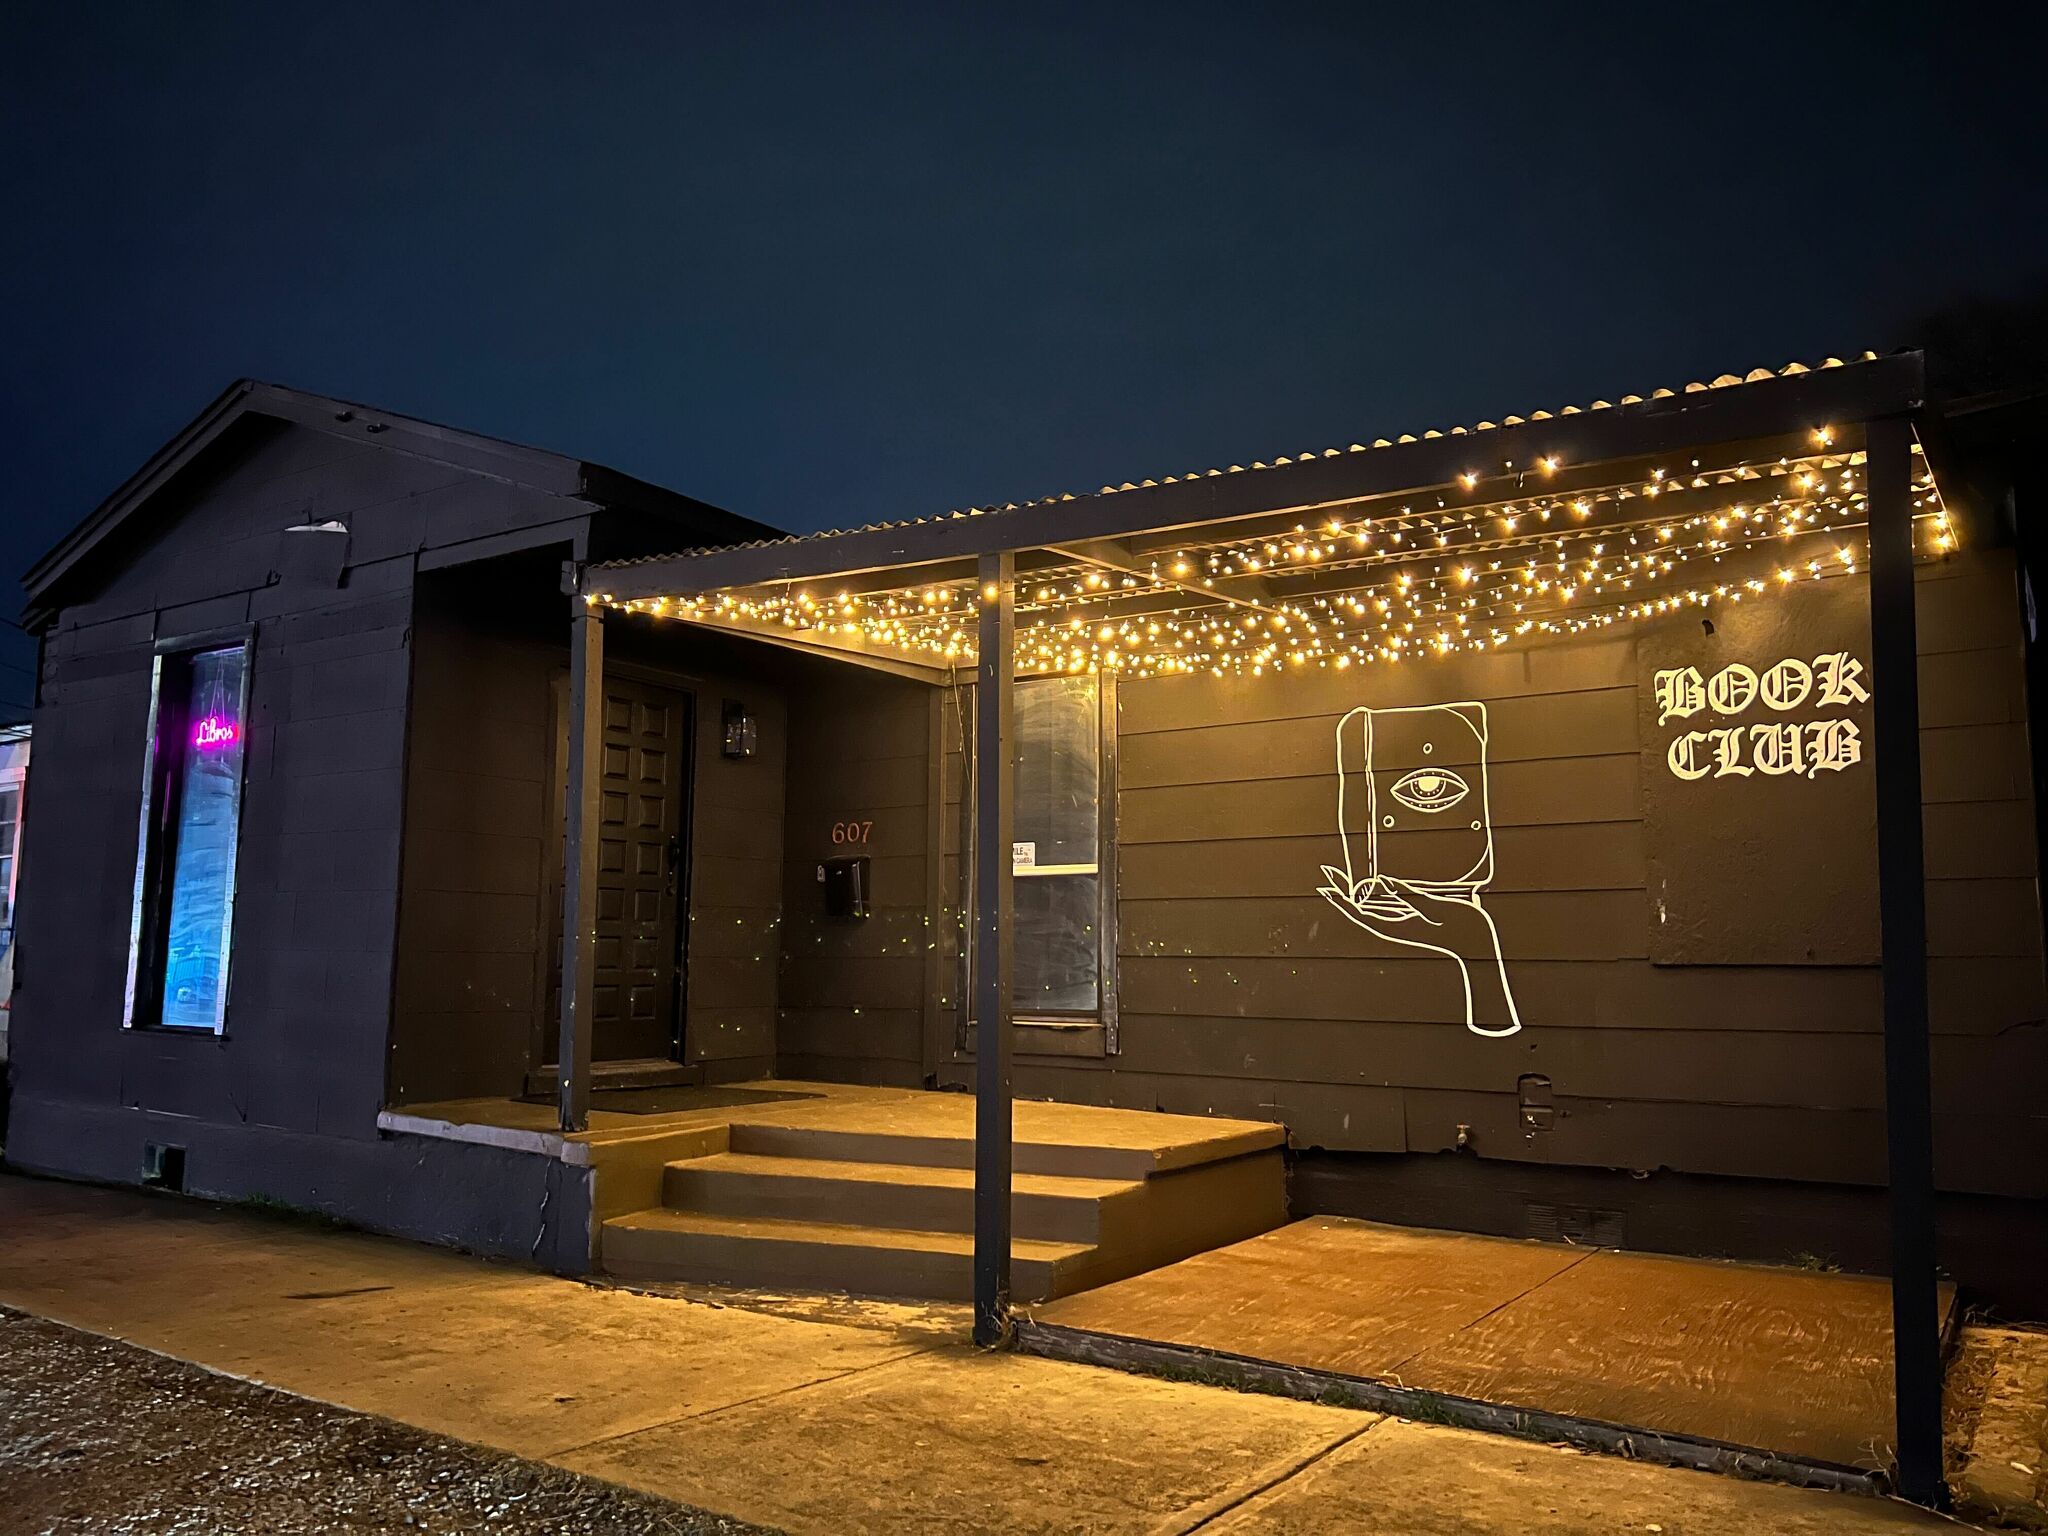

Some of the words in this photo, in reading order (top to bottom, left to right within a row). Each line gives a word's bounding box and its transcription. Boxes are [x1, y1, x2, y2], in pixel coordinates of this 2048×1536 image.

[1654, 652, 1870, 726] BOOK
[196, 717, 233, 746] Libros
[1667, 718, 1861, 780] CLUB
[832, 821, 873, 843] 607
